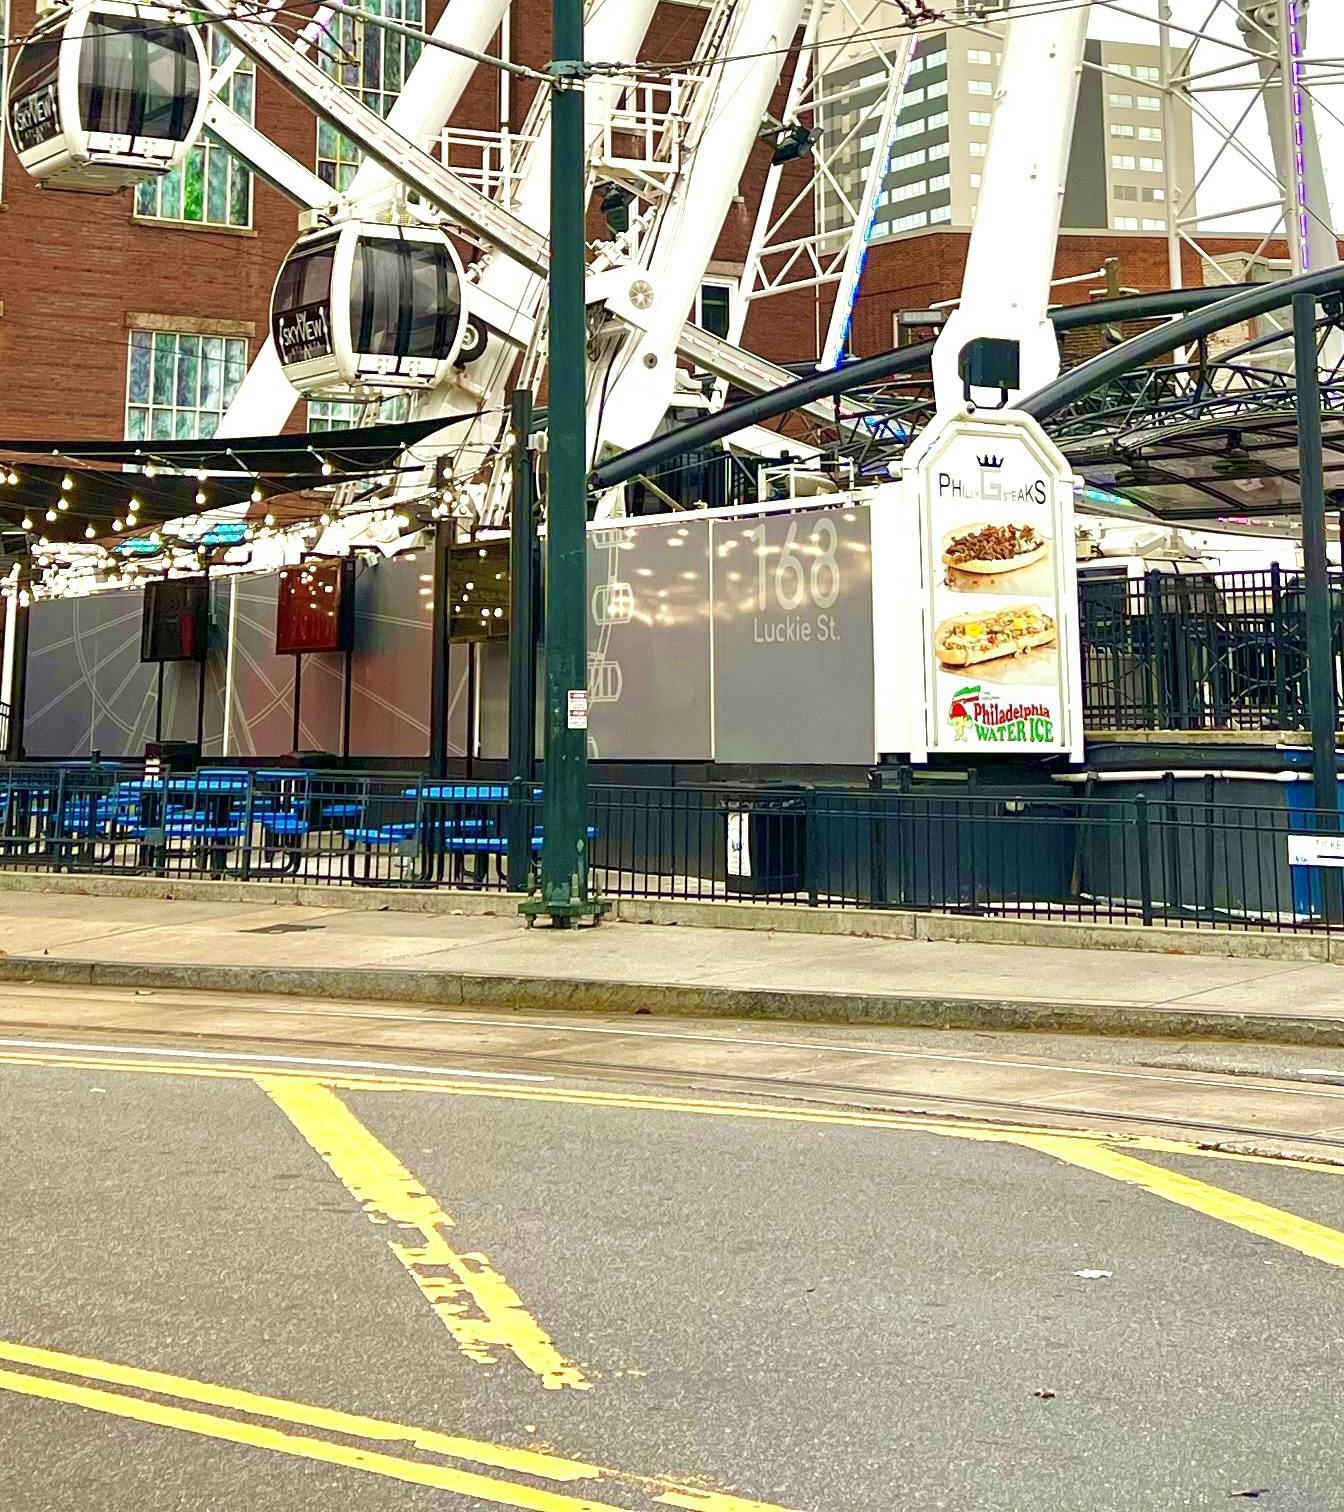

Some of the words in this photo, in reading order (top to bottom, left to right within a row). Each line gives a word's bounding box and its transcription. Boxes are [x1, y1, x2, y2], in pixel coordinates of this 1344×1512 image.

[283, 310, 322, 346] SKYVIEW
[1003, 479, 1047, 505] STEAKS
[750, 517, 840, 612] 168
[753, 615, 812, 643] Luckie
[816, 614, 841, 642] St.
[973, 702, 1050, 726] Philadelphia
[975, 720, 1027, 742] WATER
[1029, 716, 1054, 743] ICE
